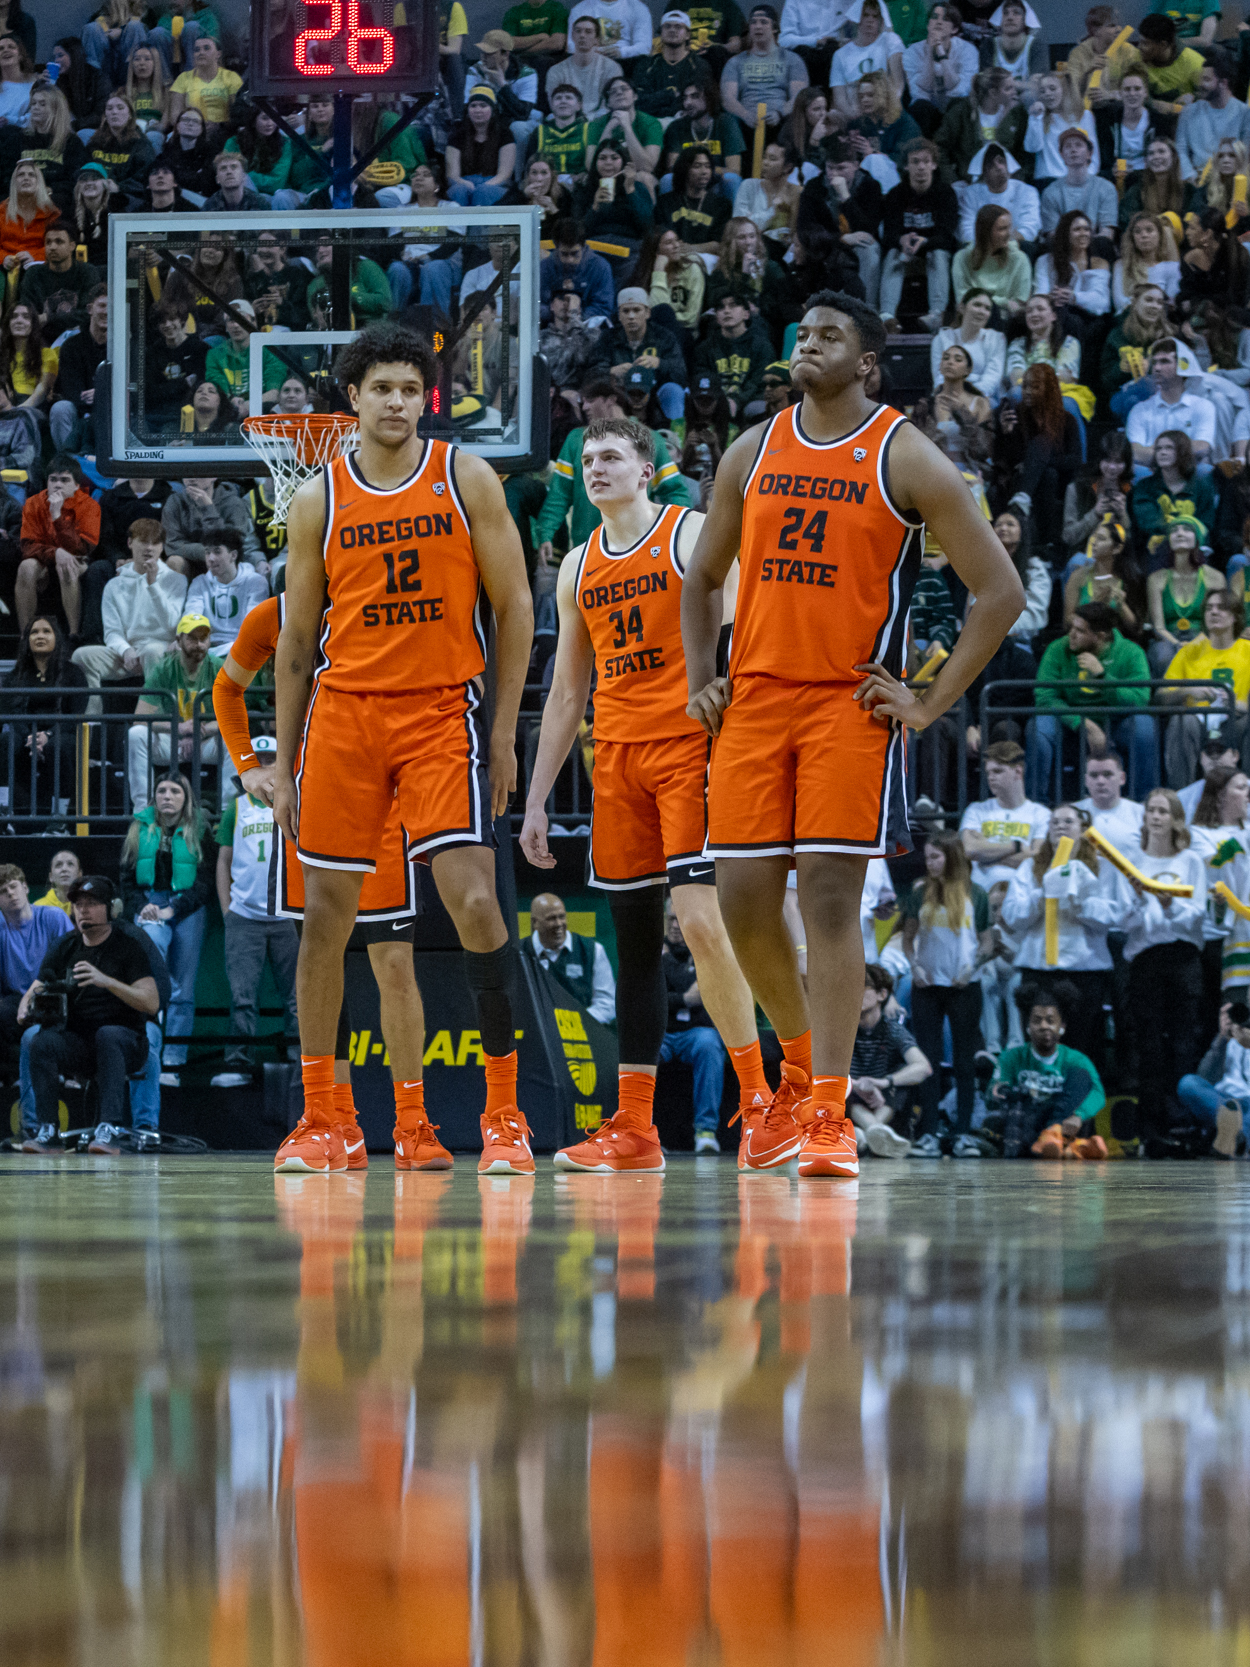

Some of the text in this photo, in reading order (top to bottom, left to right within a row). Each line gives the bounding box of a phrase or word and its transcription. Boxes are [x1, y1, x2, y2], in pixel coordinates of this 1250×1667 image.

[294, 0, 394, 76] 26
[124, 450, 164, 460] SPALDING
[758, 473, 869, 505] OREGON
[339, 512, 453, 549] OREGON
[778, 507, 828, 553] 24
[382, 549, 422, 594] 12
[761, 558, 838, 588] STATE
[582, 570, 668, 610] OREGON
[362, 597, 443, 627] STATE
[608, 605, 644, 649] 34
[604, 647, 665, 678] STATE
[256, 738, 269, 749] O
[257, 839, 266, 862] 1
